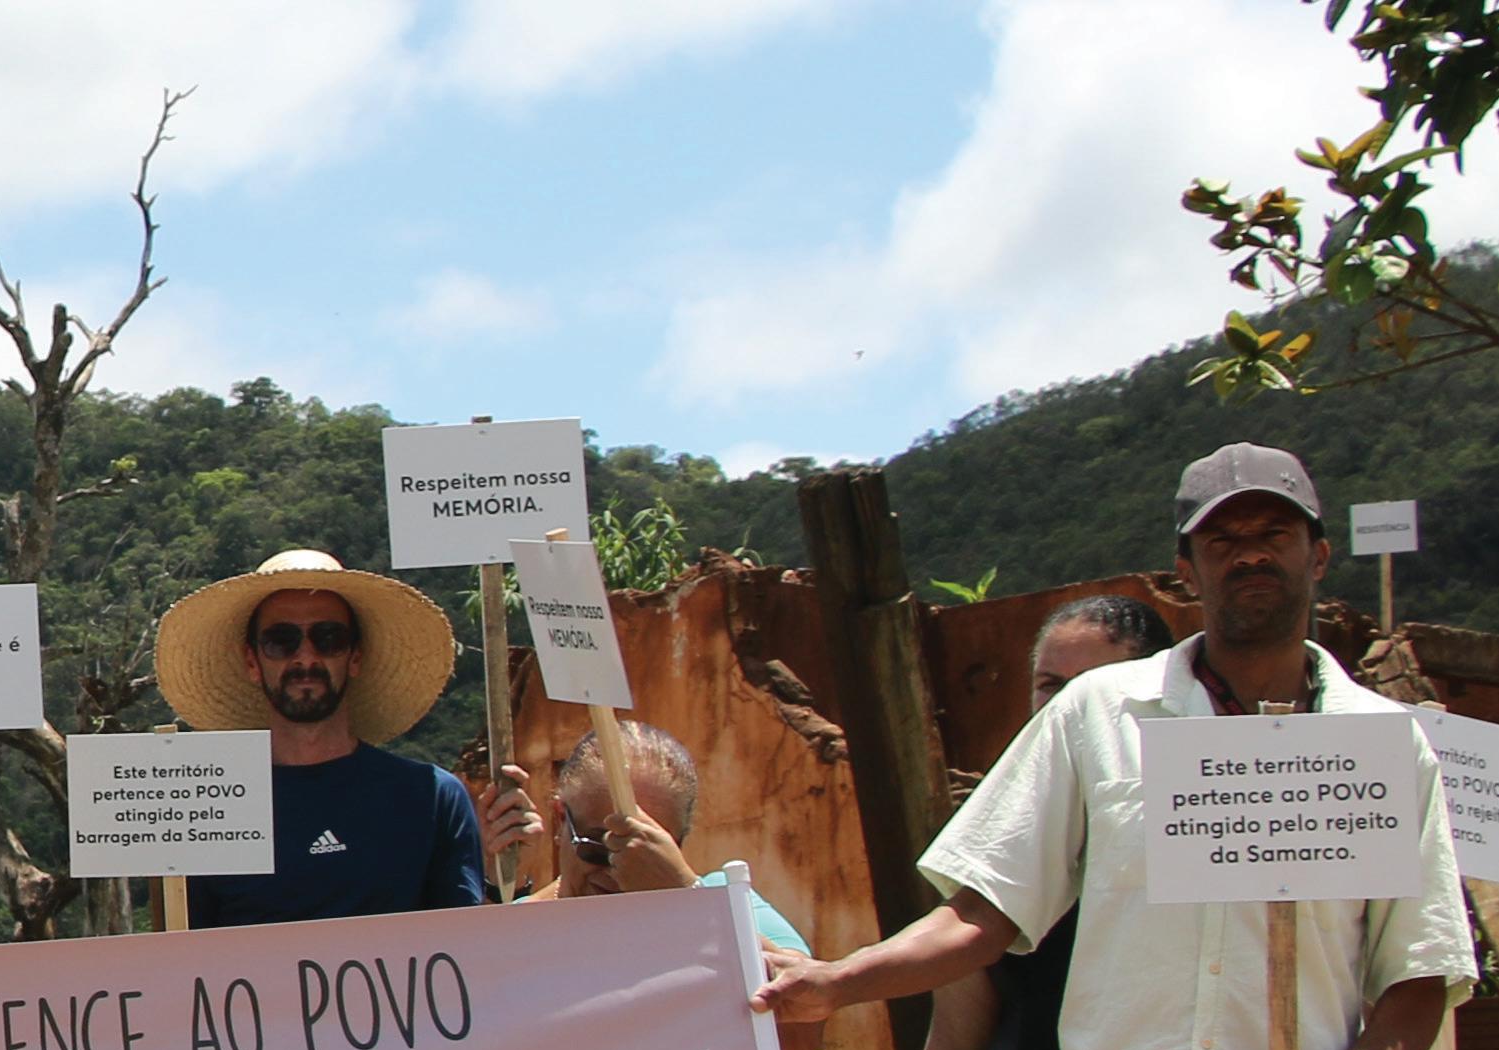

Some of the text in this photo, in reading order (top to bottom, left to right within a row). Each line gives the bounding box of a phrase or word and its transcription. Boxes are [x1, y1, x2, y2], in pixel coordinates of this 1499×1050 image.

[401, 472, 570, 494] Respeitem nossa
[433, 494, 542, 517] MEMÓRIA.
[9, 637, 20, 652] é
[548, 625, 599, 650] MEMÓRIA.
[114, 764, 224, 779] Este território
[1201, 754, 1355, 776] Este território
[93, 784, 245, 803] pertence ao POVO
[1173, 782, 1386, 811] pertence ao POVO
[115, 806, 224, 824] atingido pela
[1165, 812, 1398, 839] atingido pelo rejeito
[76, 828, 265, 847] barragem da Samarco.
[1451, 828, 1486, 844] arco.
[309, 843, 347, 854] adidas
[1210, 845, 1355, 864] da Samarco.
